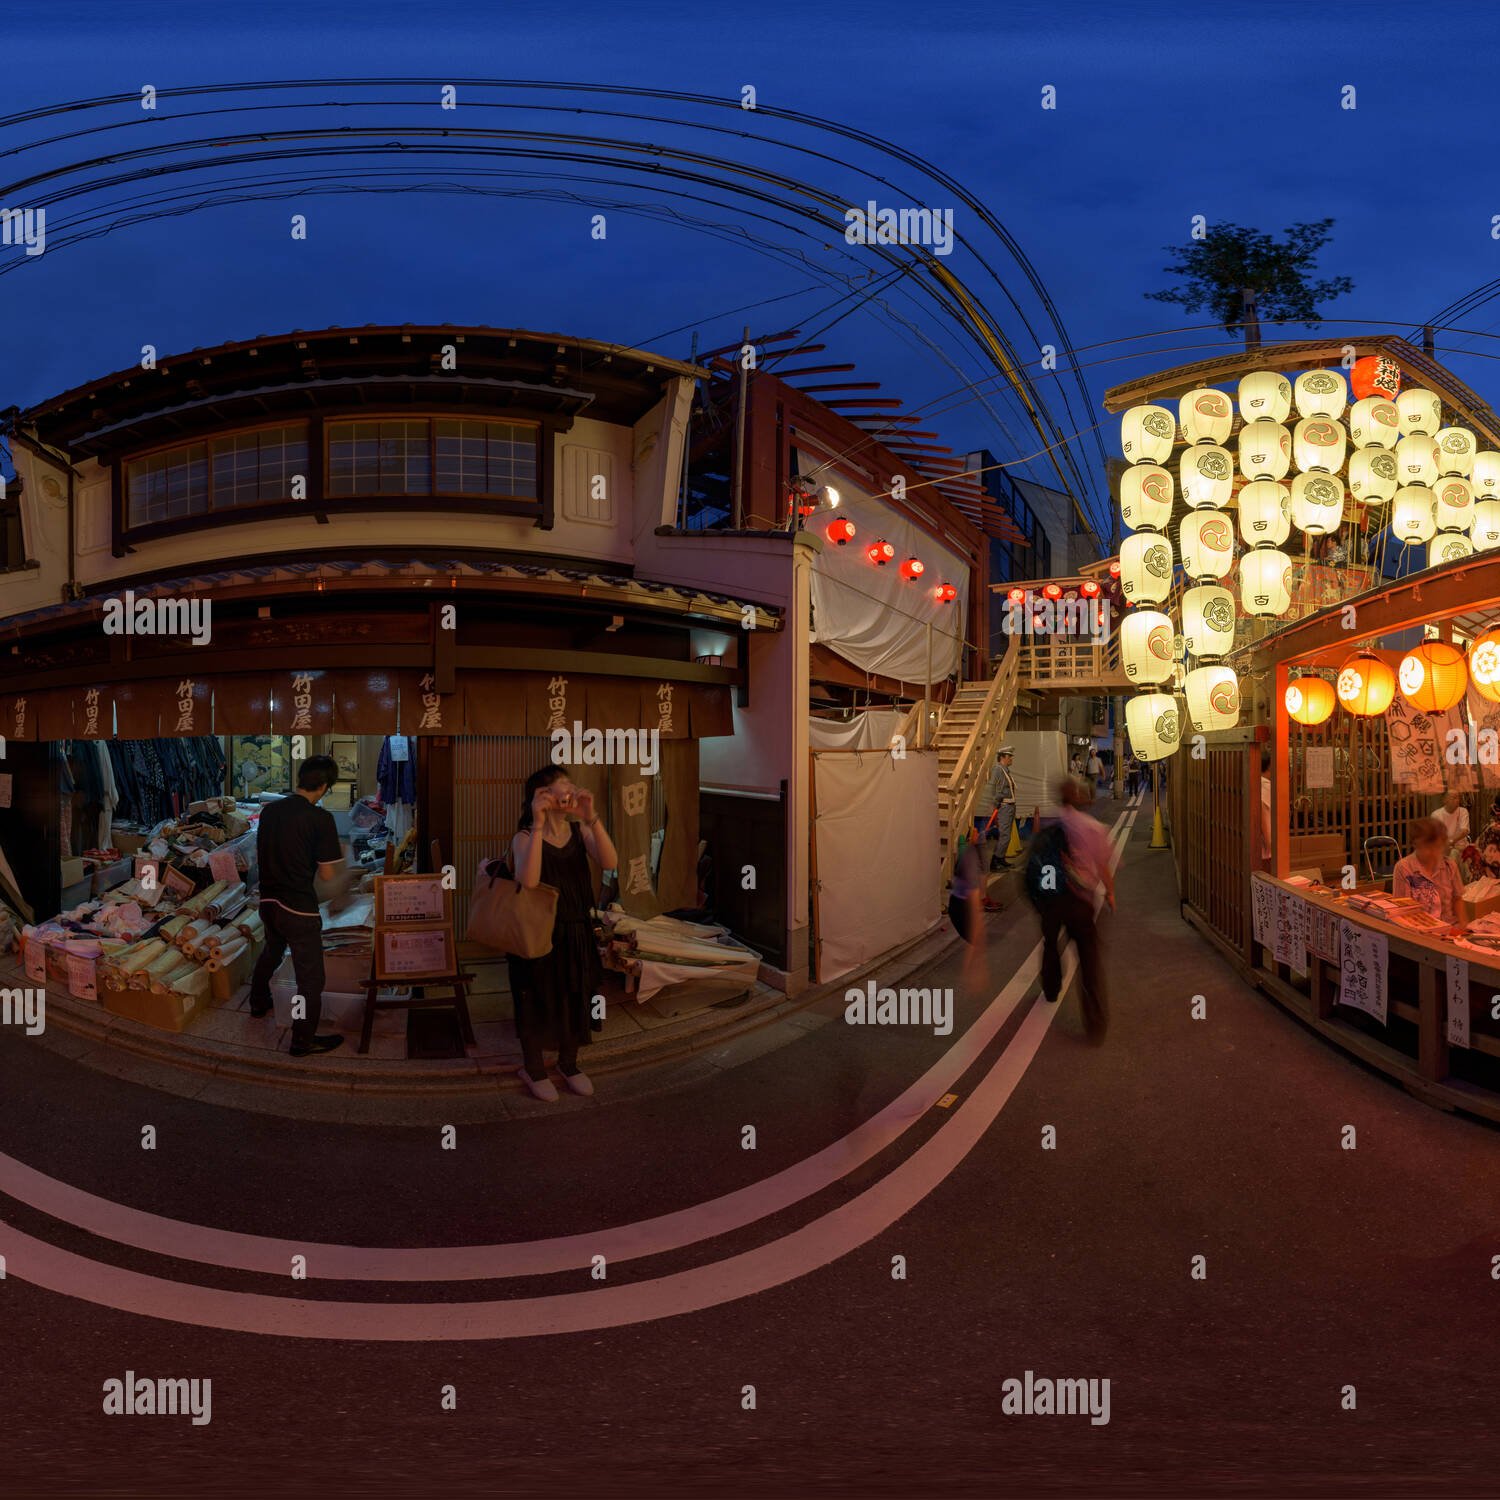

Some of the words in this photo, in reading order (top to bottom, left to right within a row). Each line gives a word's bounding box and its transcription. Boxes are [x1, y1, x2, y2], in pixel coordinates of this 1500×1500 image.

[83, 688, 101, 736] 竹田屋
[173, 677, 196, 733] 竹田屋
[290, 672, 314, 731] 竹田屋
[546, 674, 569, 731] 竹田屋
[656, 682, 675, 733] 竹田屋
